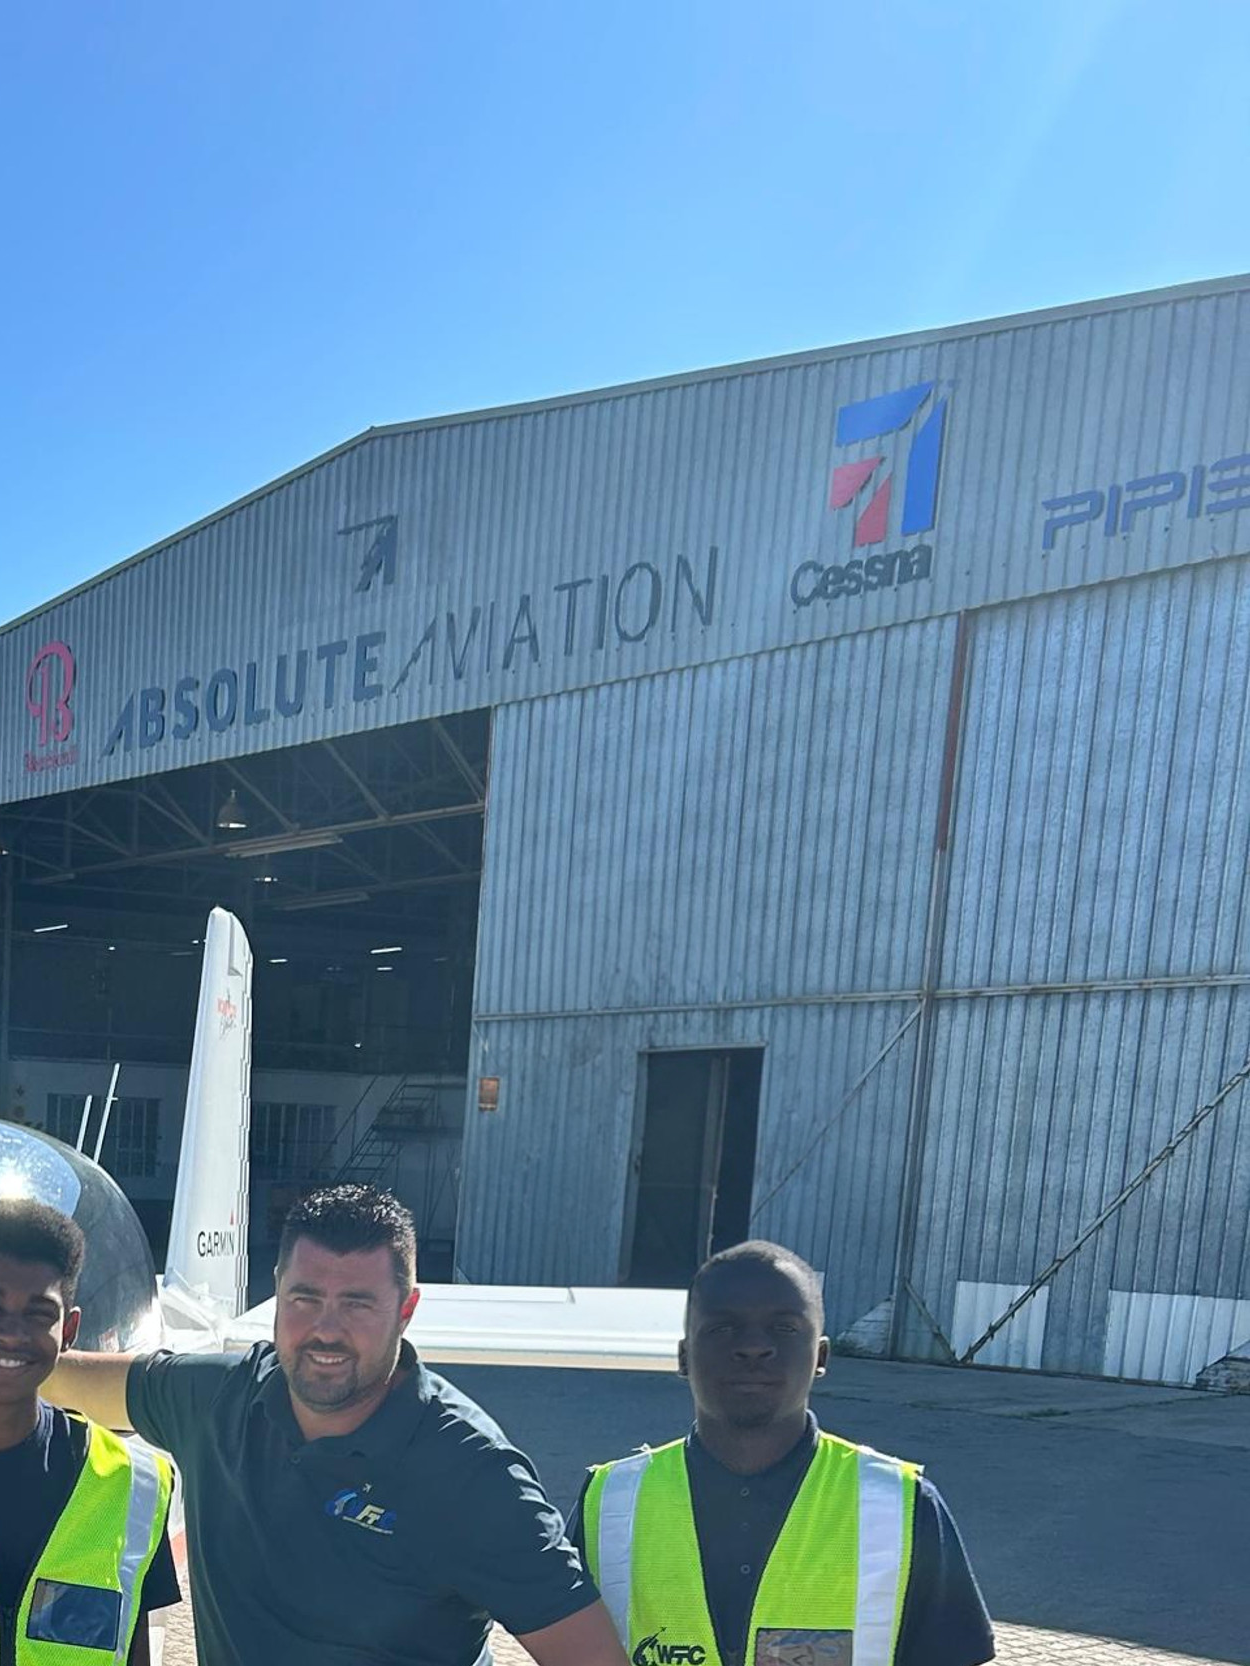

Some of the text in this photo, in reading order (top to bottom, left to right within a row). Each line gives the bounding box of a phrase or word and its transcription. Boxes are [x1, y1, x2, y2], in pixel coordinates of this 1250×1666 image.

[790, 543, 933, 608] Cessna
[102, 546, 719, 757] ABSOLUTE AVIATION
[196, 1230, 235, 1257] GARMIN
[656, 1644, 706, 1666] WFC
